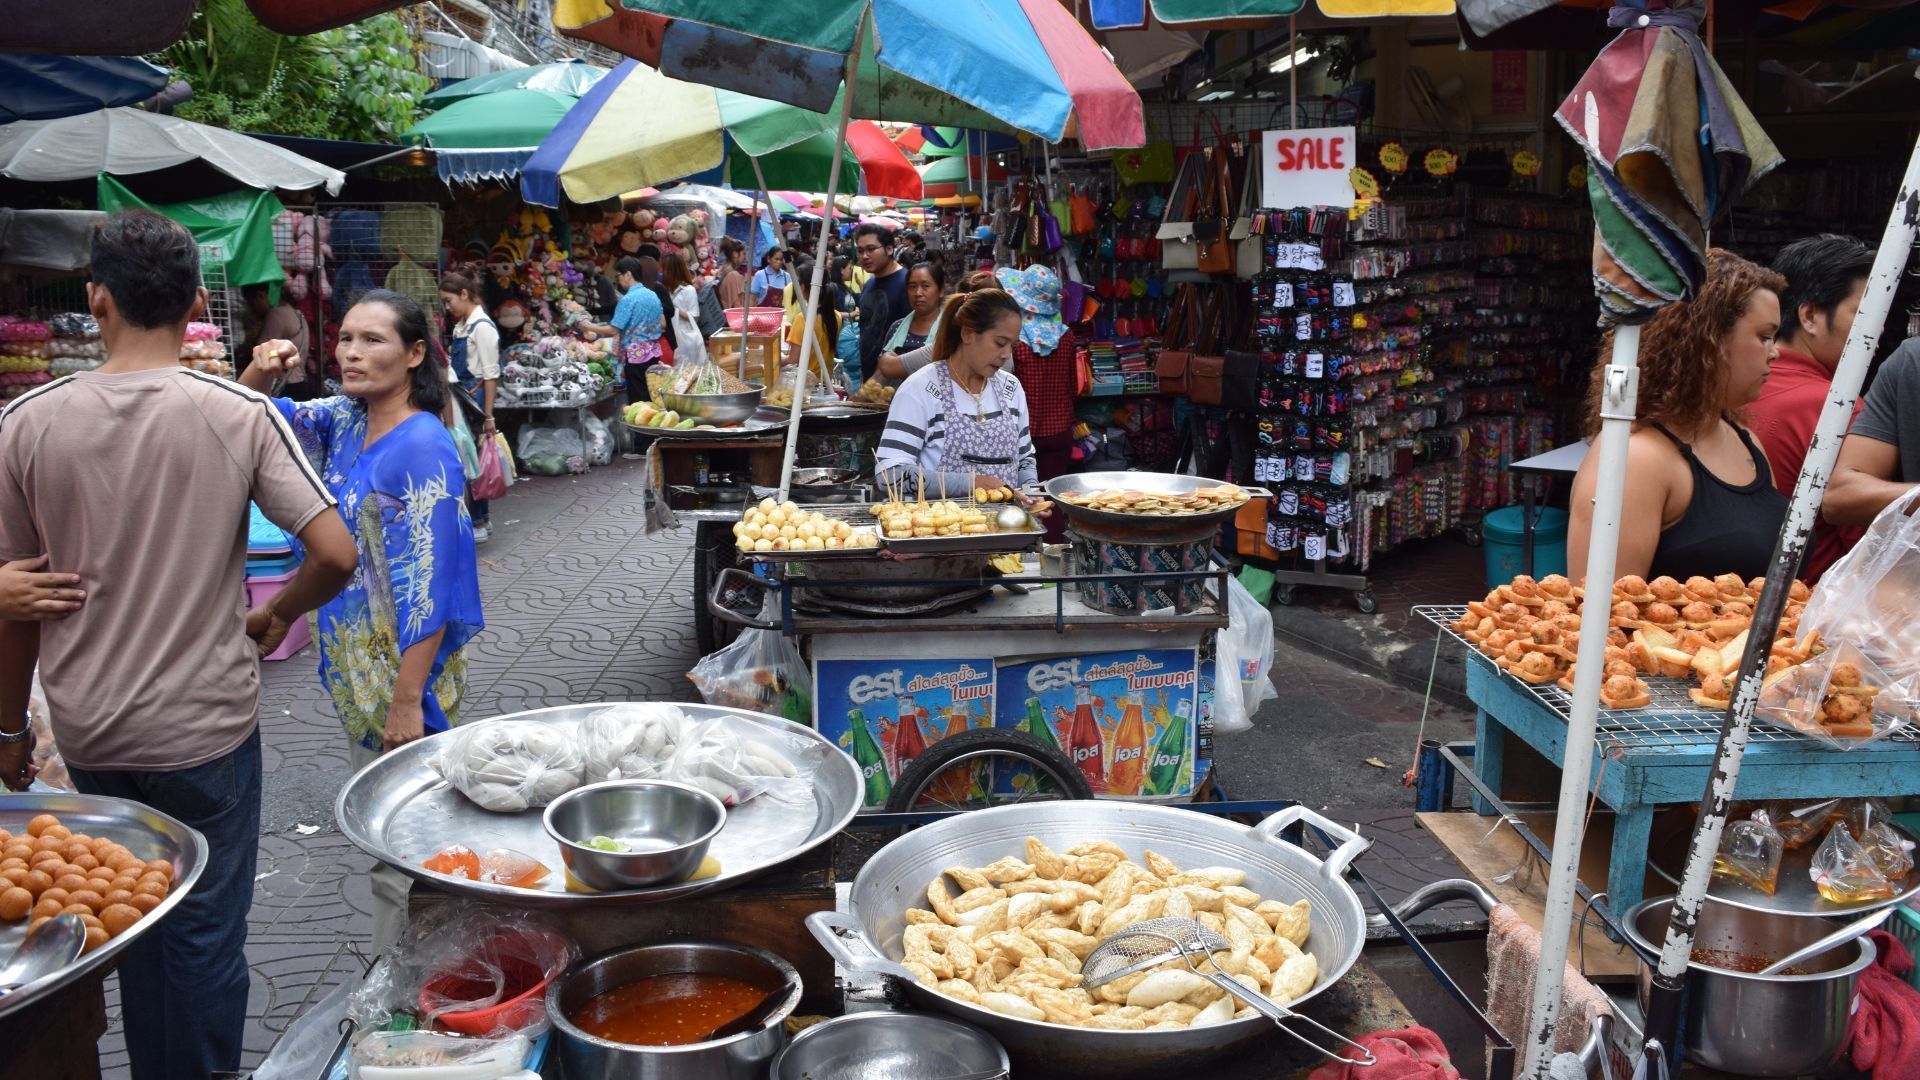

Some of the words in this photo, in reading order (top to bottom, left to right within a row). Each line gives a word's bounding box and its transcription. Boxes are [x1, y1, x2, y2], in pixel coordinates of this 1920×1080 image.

[1277, 136, 1345, 171] SALE
[928, 384, 942, 398] HB
[1003, 380, 1017, 399] HBA
[848, 668, 905, 705] est
[1027, 657, 1082, 693] est
